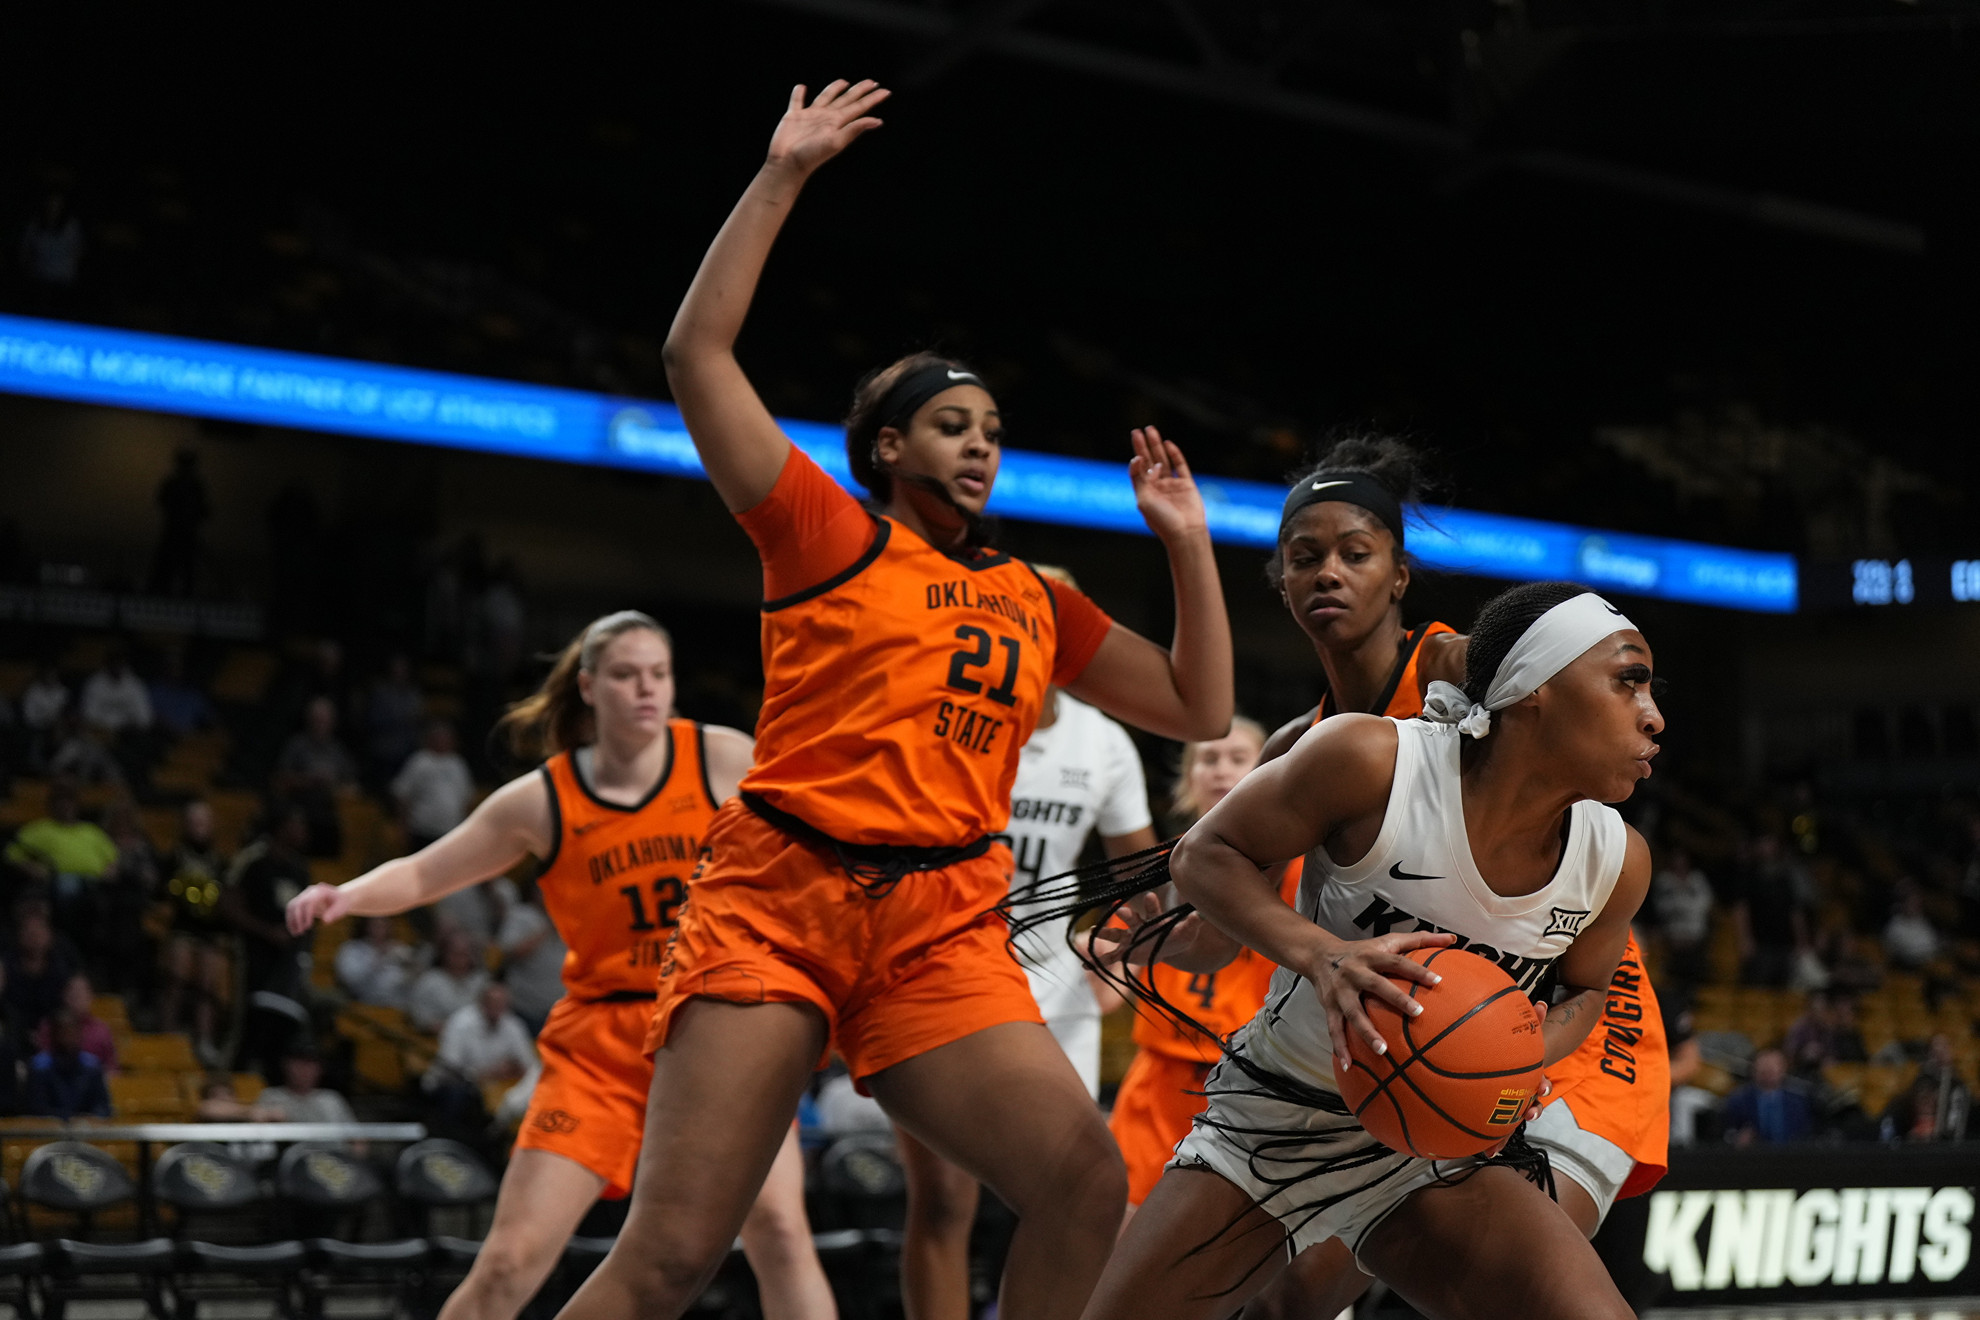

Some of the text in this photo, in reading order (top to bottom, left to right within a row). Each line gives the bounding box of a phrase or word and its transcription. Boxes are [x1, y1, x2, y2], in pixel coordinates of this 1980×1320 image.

[926, 579, 1041, 650] OKLAHOMA
[947, 624, 1020, 707] 21
[934, 701, 1003, 754] STATE
[619, 876, 683, 931] 12
[1643, 1187, 1974, 1291] KNIGHTS
